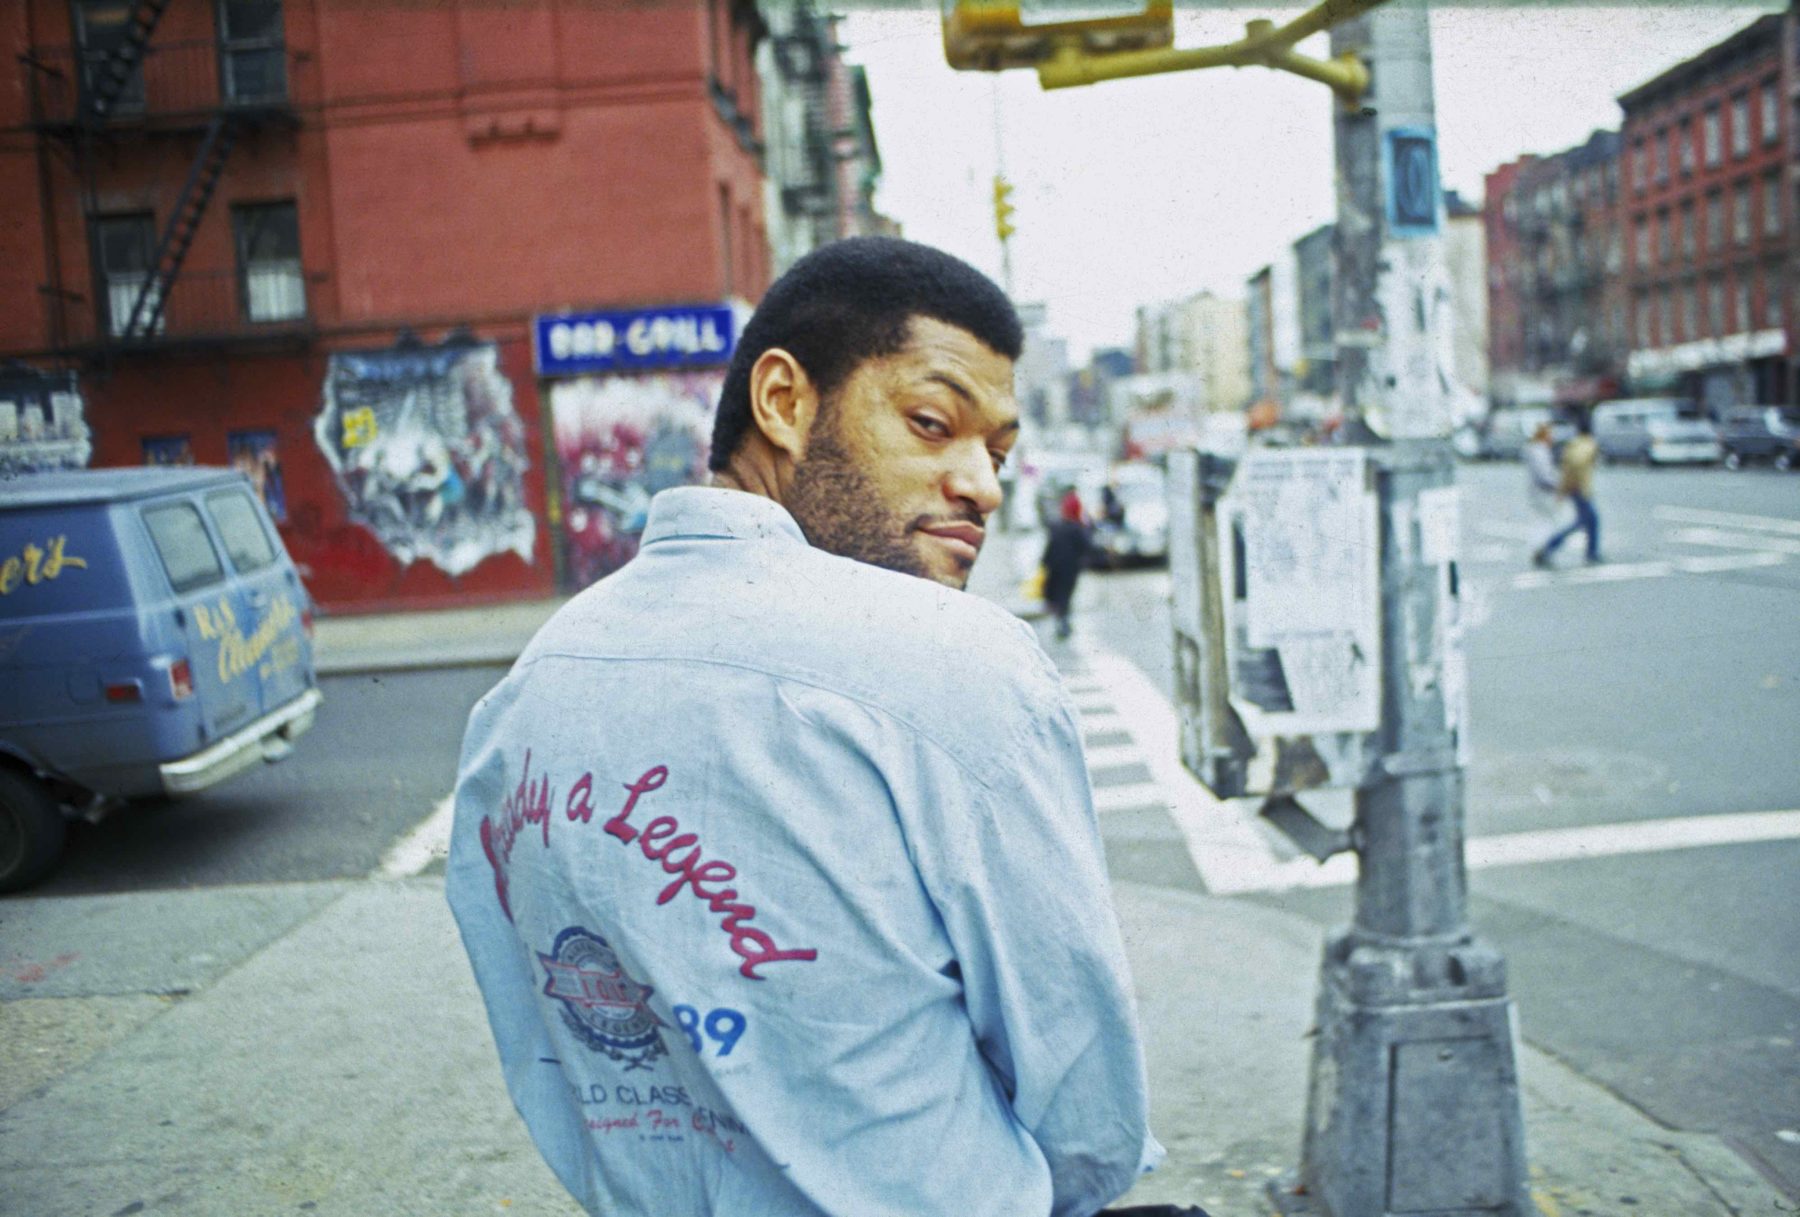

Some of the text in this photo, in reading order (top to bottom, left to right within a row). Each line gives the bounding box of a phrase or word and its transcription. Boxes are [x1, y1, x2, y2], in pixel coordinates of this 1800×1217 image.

[566, 771, 595, 824] a
[603, 764, 818, 982] Legend
[672, 1003, 747, 1057] 89
